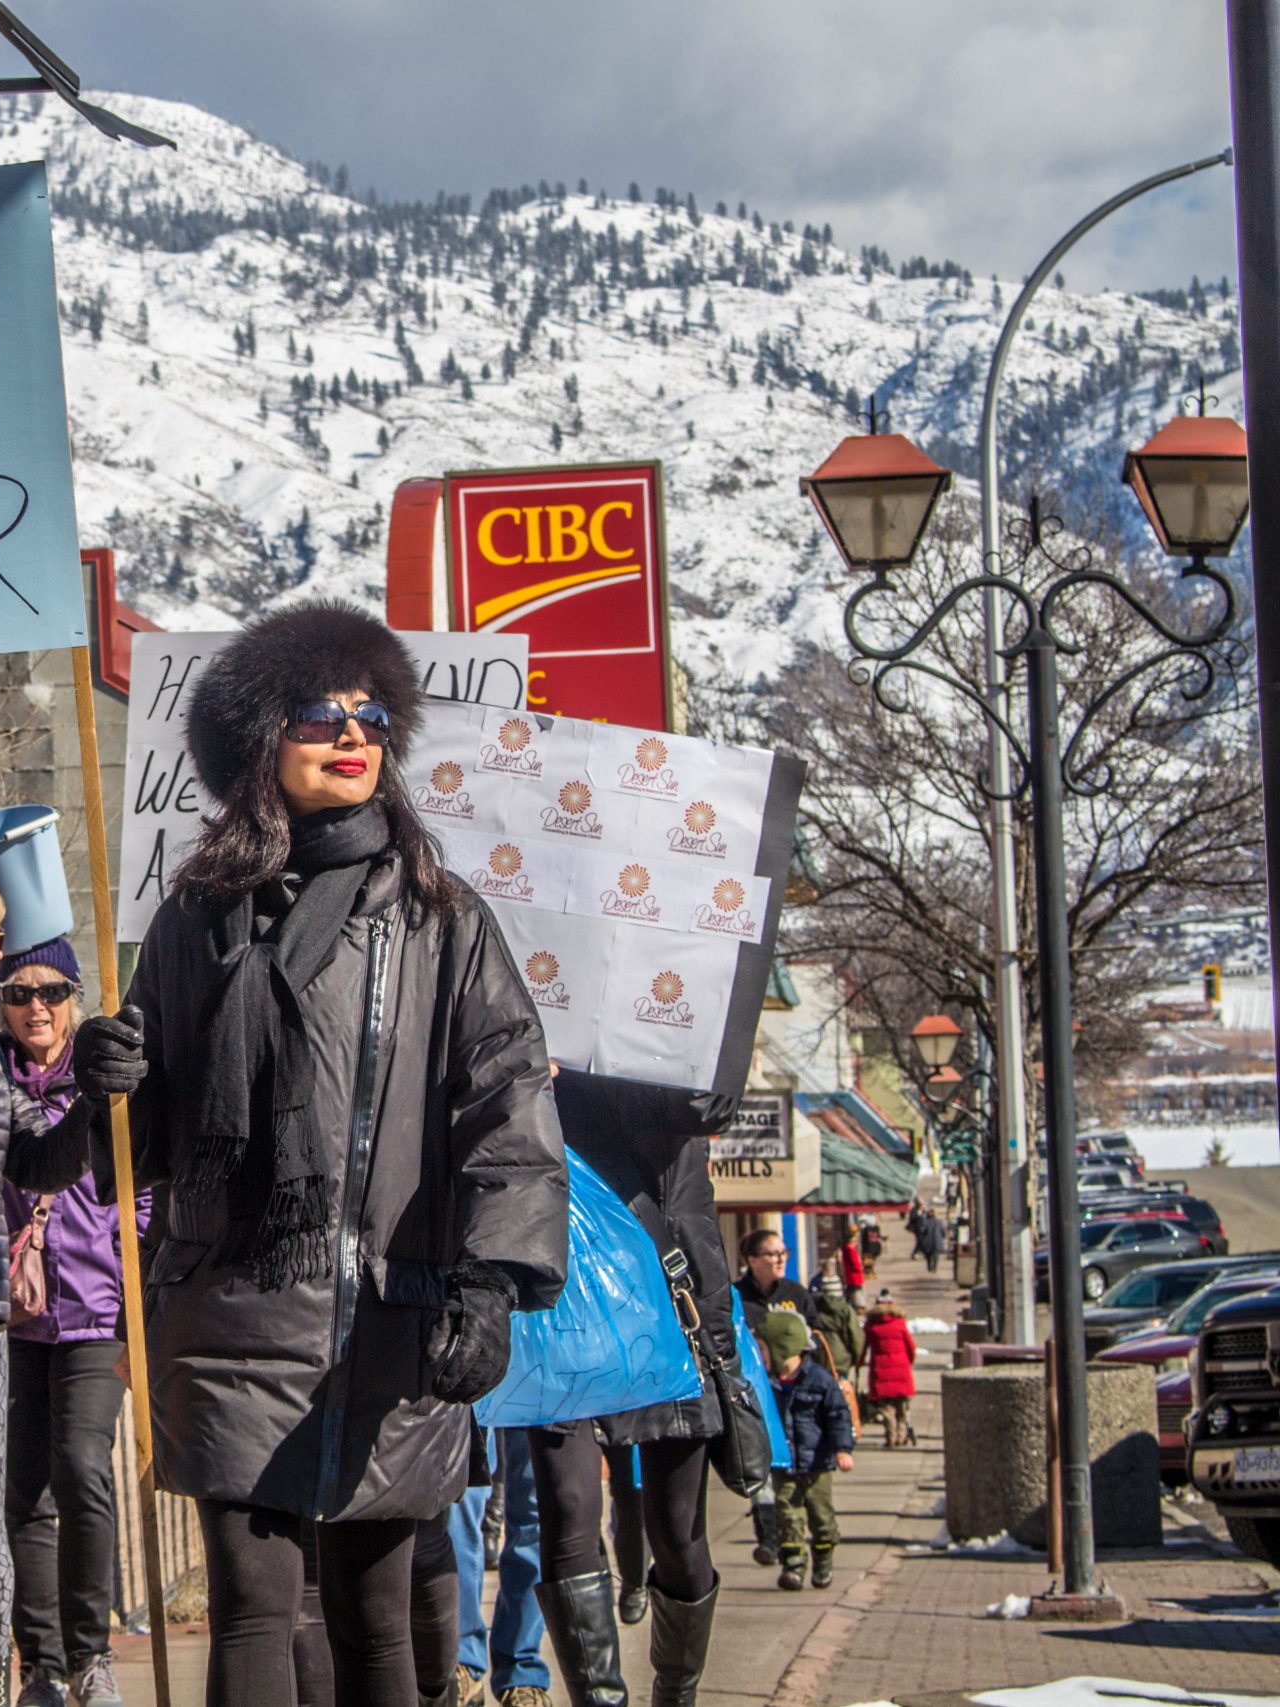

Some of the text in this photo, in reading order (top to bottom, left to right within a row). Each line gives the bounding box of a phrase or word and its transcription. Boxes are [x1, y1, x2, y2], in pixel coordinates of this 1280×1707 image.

[477, 501, 635, 566] CIBC
[519, 750, 542, 772] Sun
[656, 769, 679, 792] Sun
[452, 792, 475, 815] Sun
[580, 812, 603, 835] Sun
[705, 832, 727, 854] Sun
[511, 874, 534, 897] Sun
[639, 895, 661, 917] Sun
[734, 909, 756, 932] Sun
[548, 983, 570, 1005] Sun
[672, 1002, 695, 1024] Sun
[711, 1159, 773, 1178] MILLS
